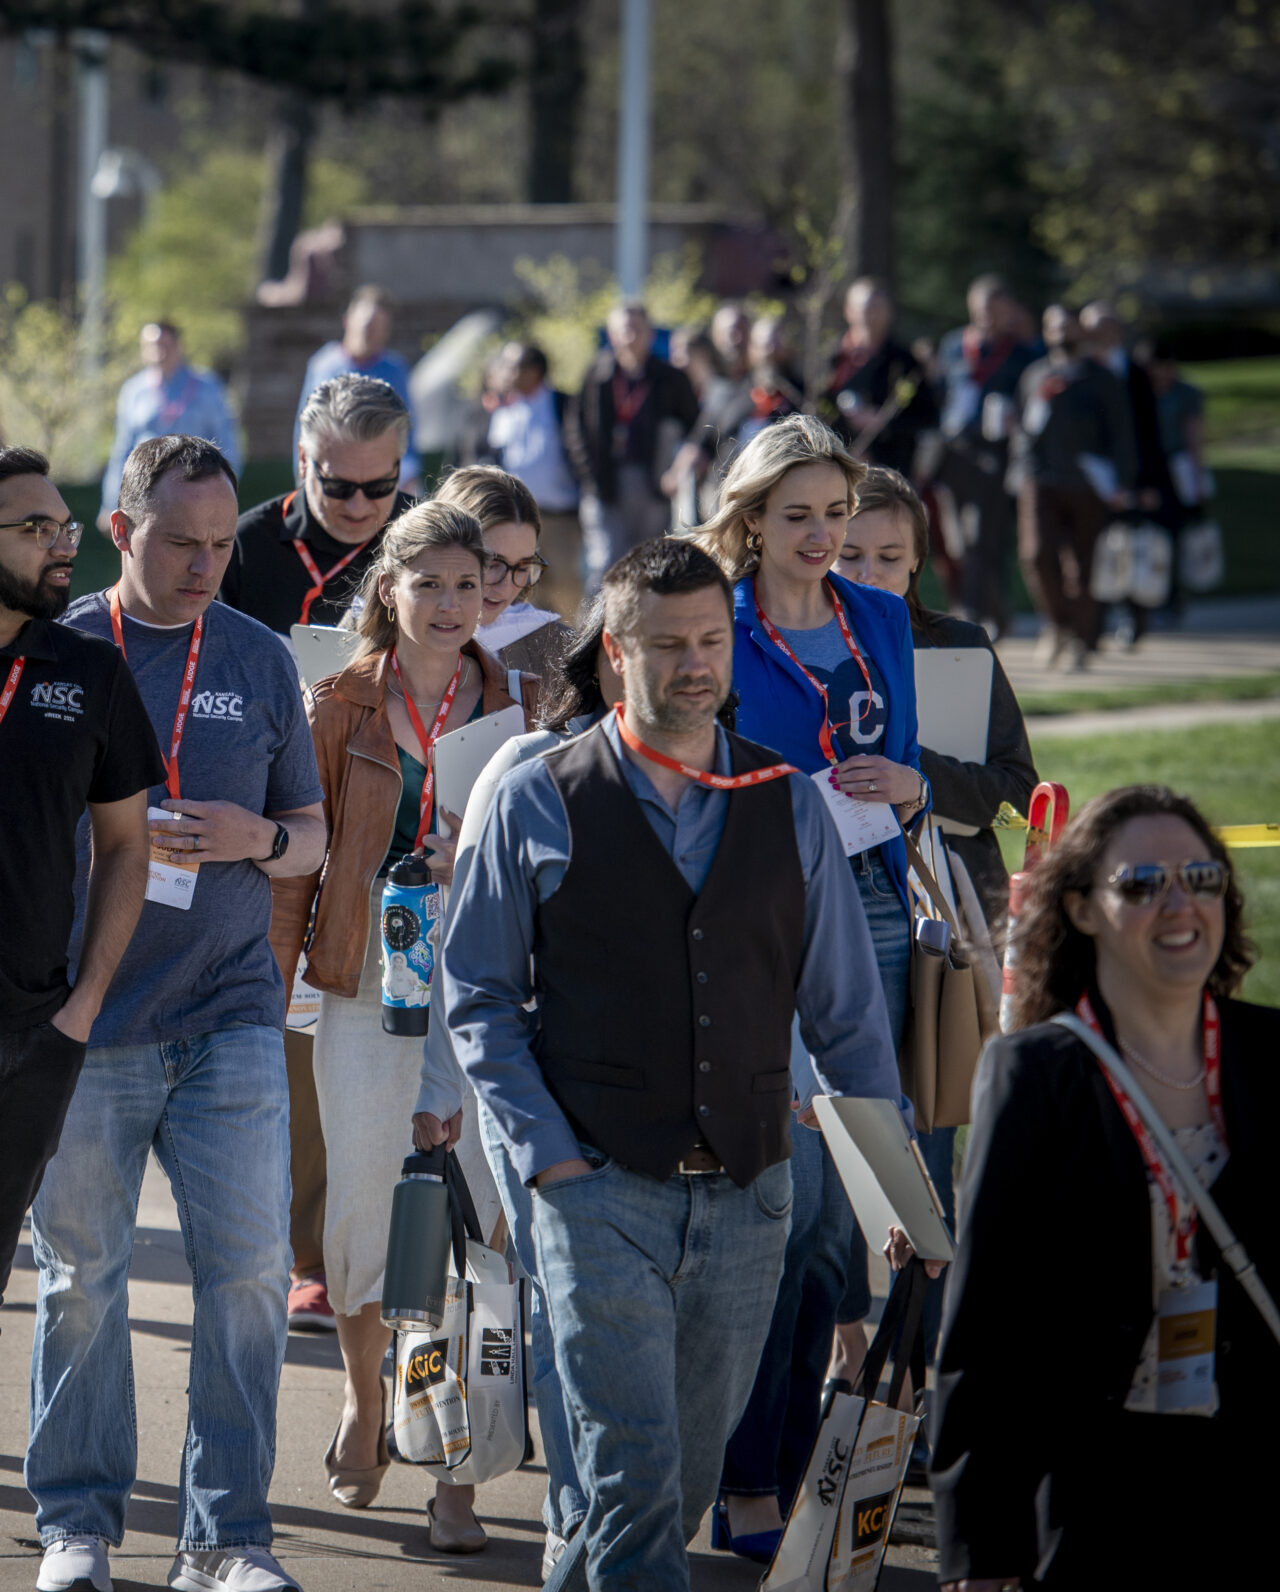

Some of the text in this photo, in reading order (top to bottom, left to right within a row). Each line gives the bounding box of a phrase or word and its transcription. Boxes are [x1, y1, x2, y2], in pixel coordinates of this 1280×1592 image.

[10, 664, 20, 684] JUDGE
[186, 661, 196, 682] JUDGE
[31, 682, 84, 708] NSC
[191, 690, 243, 716] NSC
[175, 713, 185, 733] JUDGE
[817, 1437, 849, 1507] NSC
